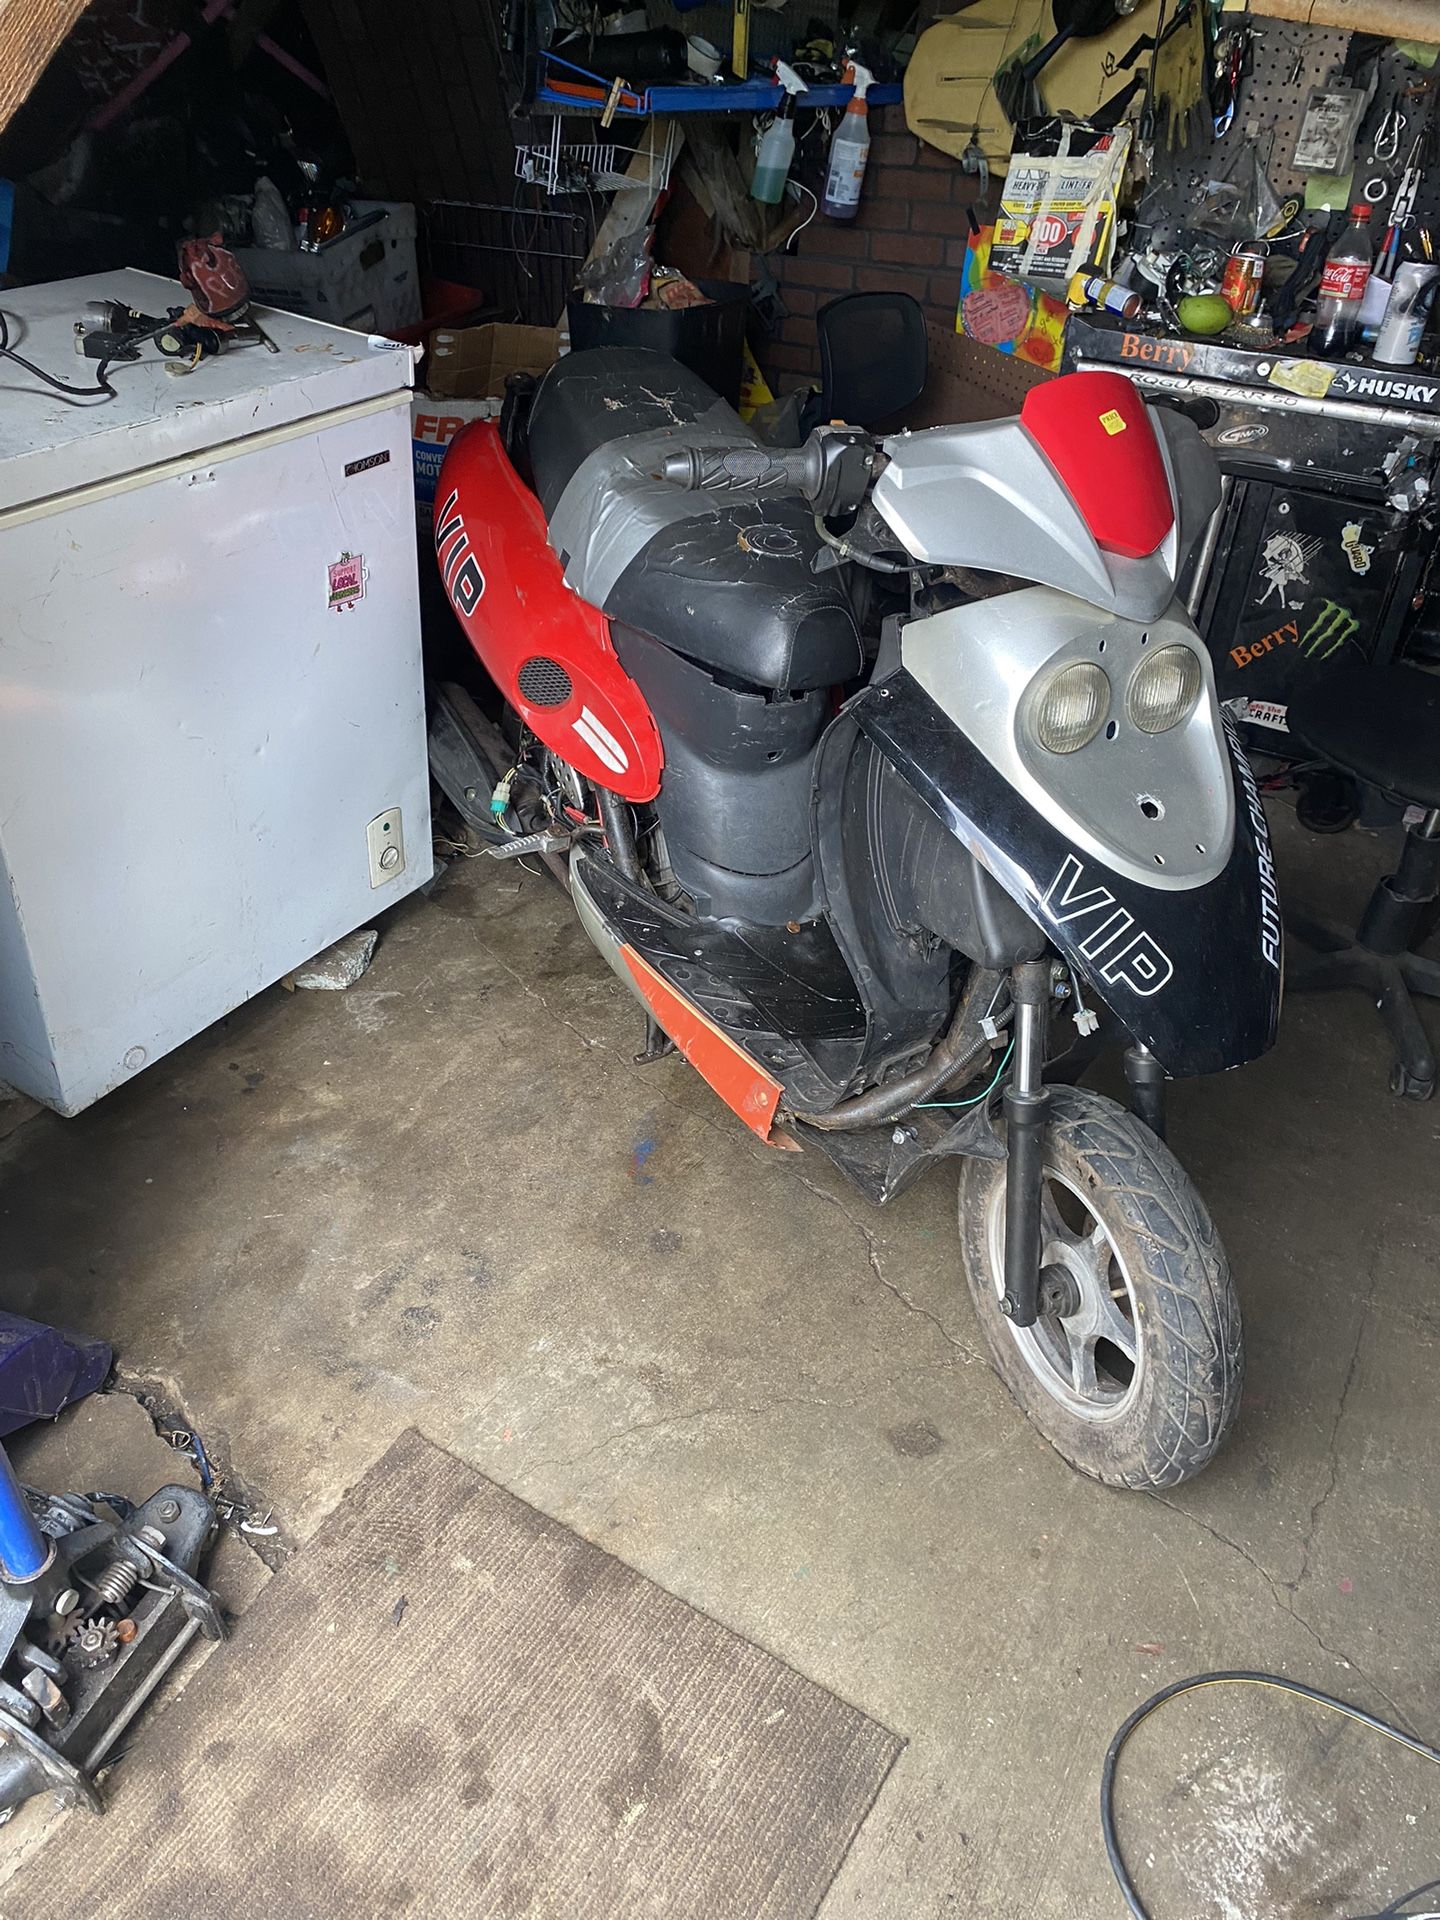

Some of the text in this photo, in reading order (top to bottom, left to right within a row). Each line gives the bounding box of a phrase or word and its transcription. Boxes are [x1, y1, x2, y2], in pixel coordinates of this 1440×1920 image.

[1121, 333, 1194, 373] Berry
[1358, 377, 1438, 403] HUSKY
[415, 449, 444, 464] CONVE
[416, 461, 441, 477] MOT
[436, 487, 486, 618] VIP
[1229, 619, 1299, 669] Berry
[1038, 853, 1174, 996] VIP
